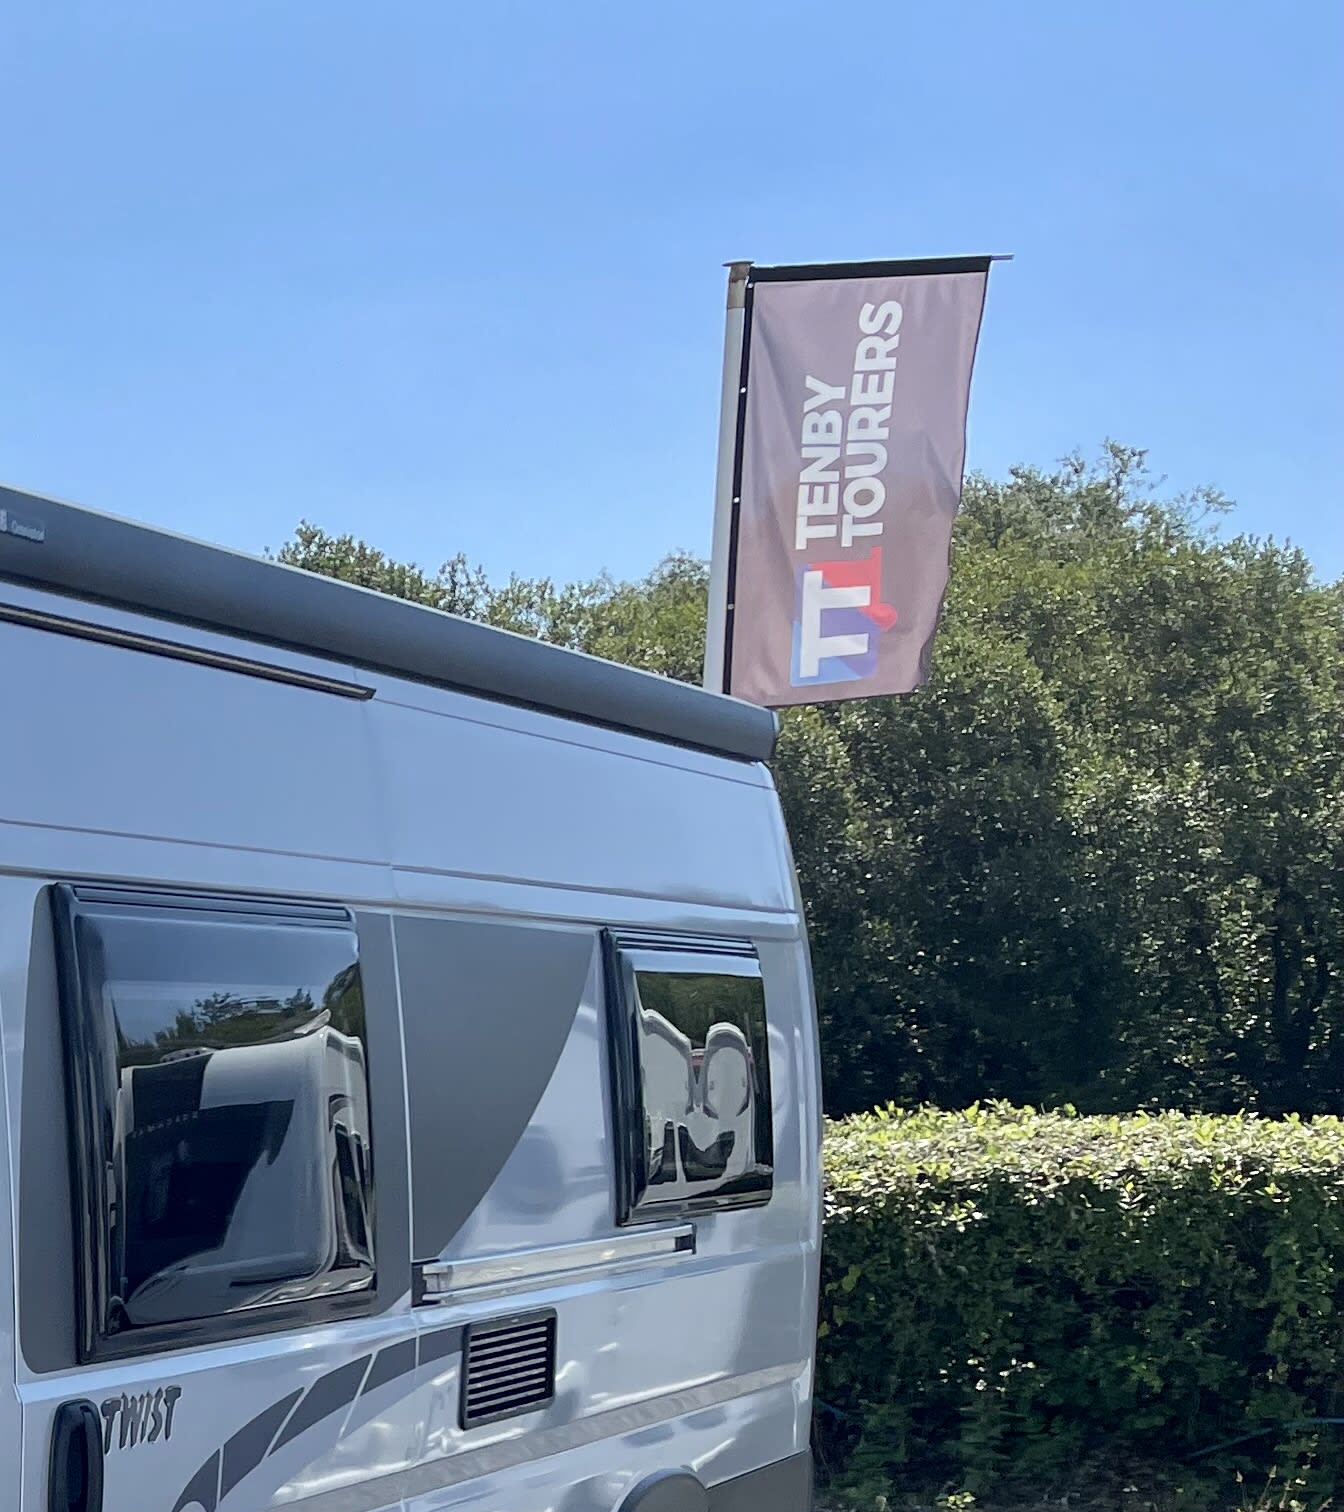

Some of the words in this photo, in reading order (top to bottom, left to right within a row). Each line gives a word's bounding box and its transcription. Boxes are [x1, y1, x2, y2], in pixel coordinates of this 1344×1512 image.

[795, 374, 846, 550] TENBY
[841, 299, 904, 547] TOURERS
[100, 1385, 182, 1456] TWIST
